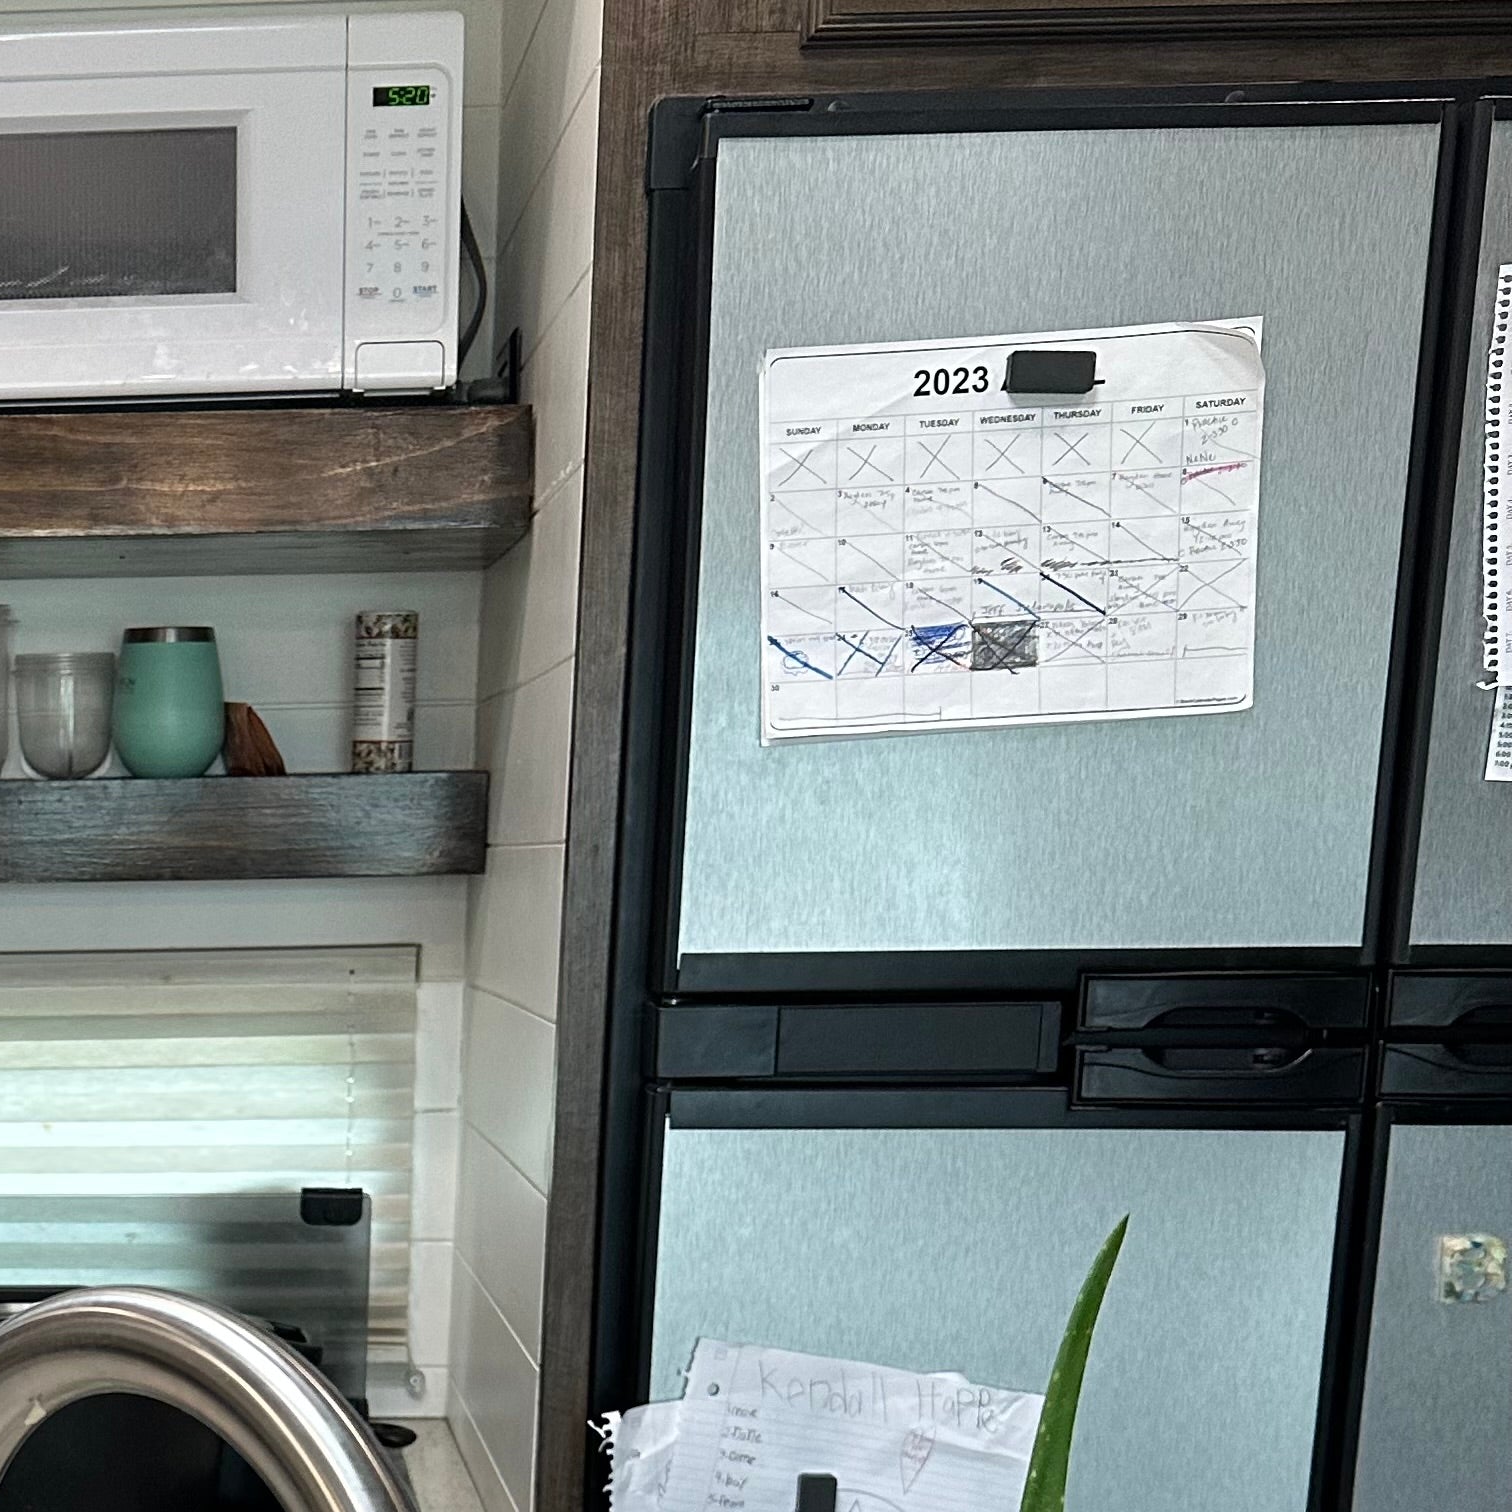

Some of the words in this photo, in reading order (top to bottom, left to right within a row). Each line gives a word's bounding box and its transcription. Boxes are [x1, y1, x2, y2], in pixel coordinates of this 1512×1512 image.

[388, 87, 429, 105] 5:20
[913, 366, 989, 397] 2023
[786, 426, 822, 436] SUNDAY
[852, 422, 890, 432] MONDAY
[919, 418, 960, 428] TUESDAY
[979, 413, 1036, 424] WEDNESDAY
[1054, 409, 1102, 420] THURSDAY
[1131, 404, 1165, 414] FRIDAY
[1195, 397, 1247, 409] SATURDAY
[758, 1359, 888, 1424] Kendall
